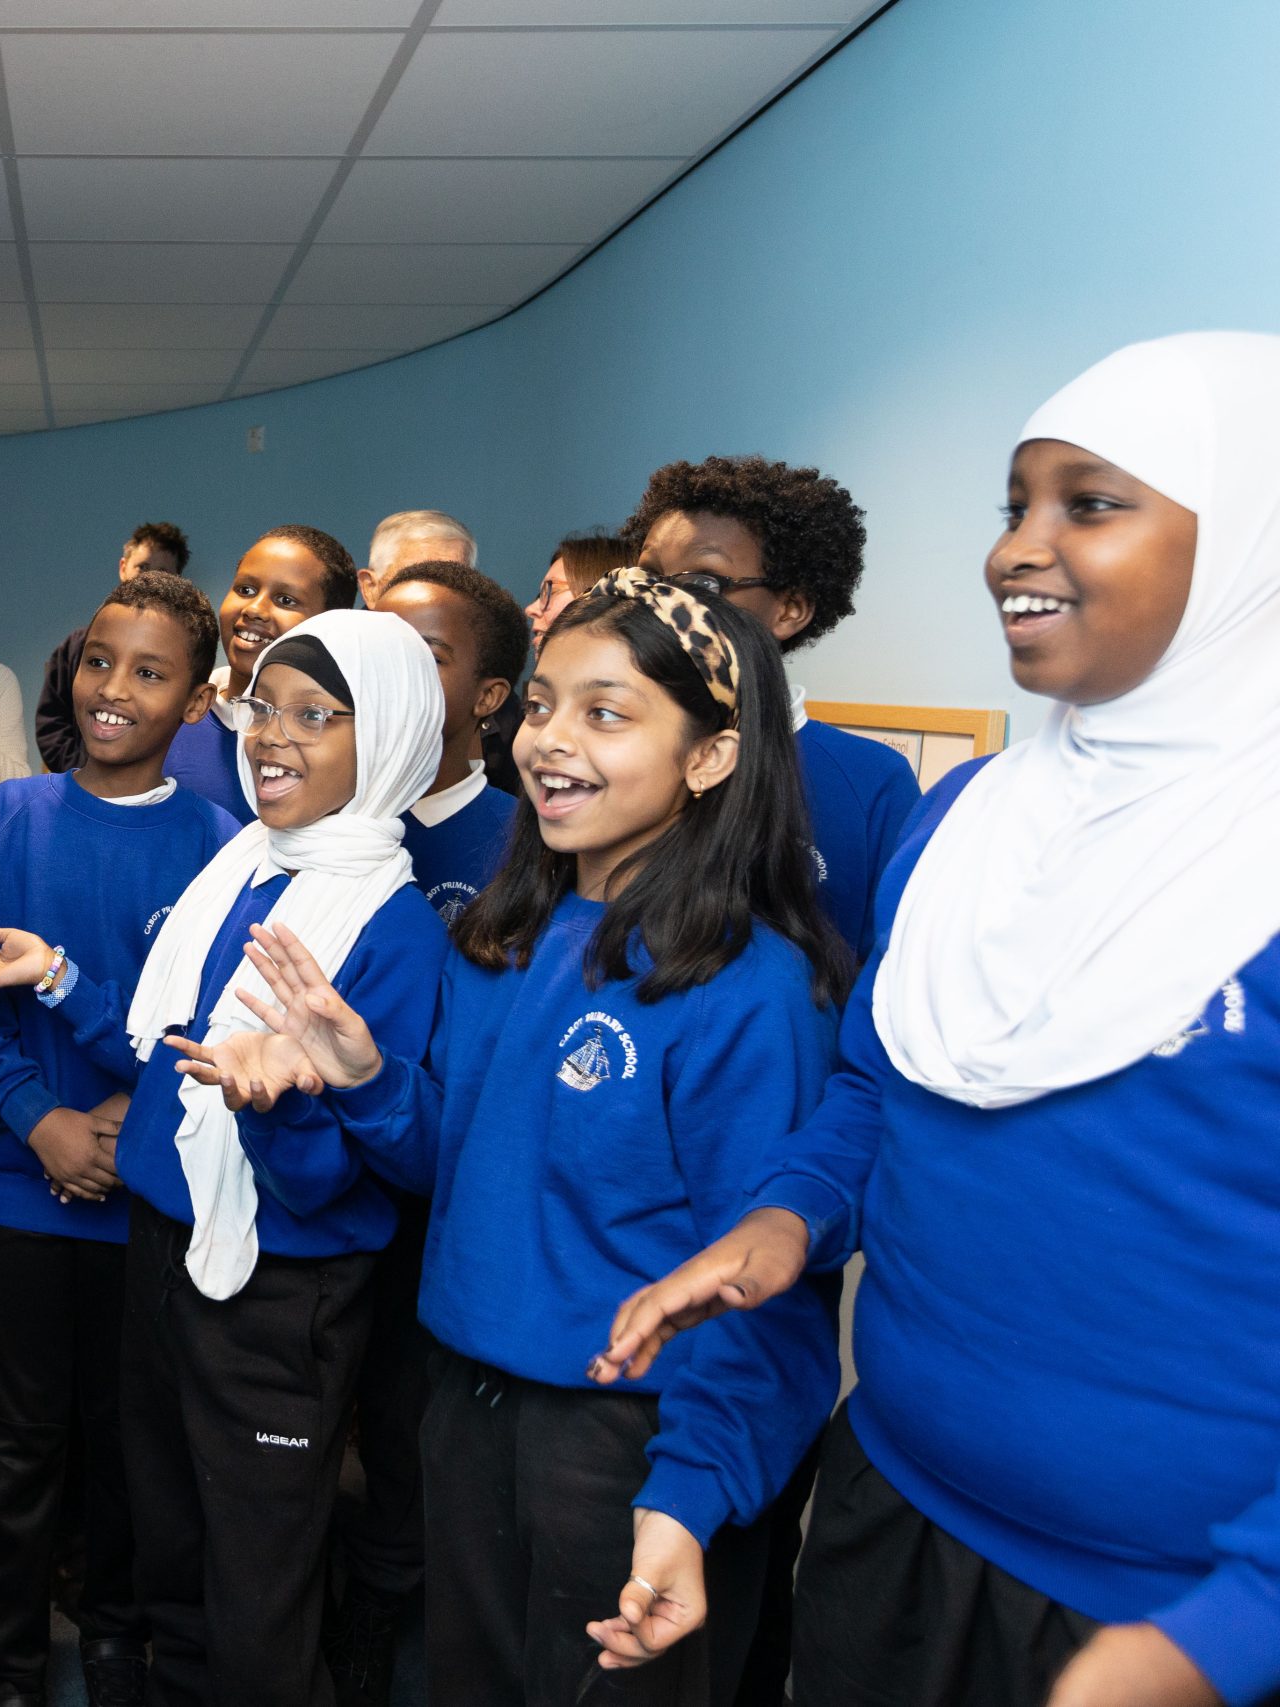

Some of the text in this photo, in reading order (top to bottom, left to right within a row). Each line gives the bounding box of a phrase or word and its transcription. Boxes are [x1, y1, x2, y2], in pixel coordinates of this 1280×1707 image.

[426, 881, 478, 901] BOT PRIMARY
[143, 911, 162, 935] CABOT
[559, 1017, 583, 1047] CABOT
[619, 1032, 638, 1080] SCHOOL
